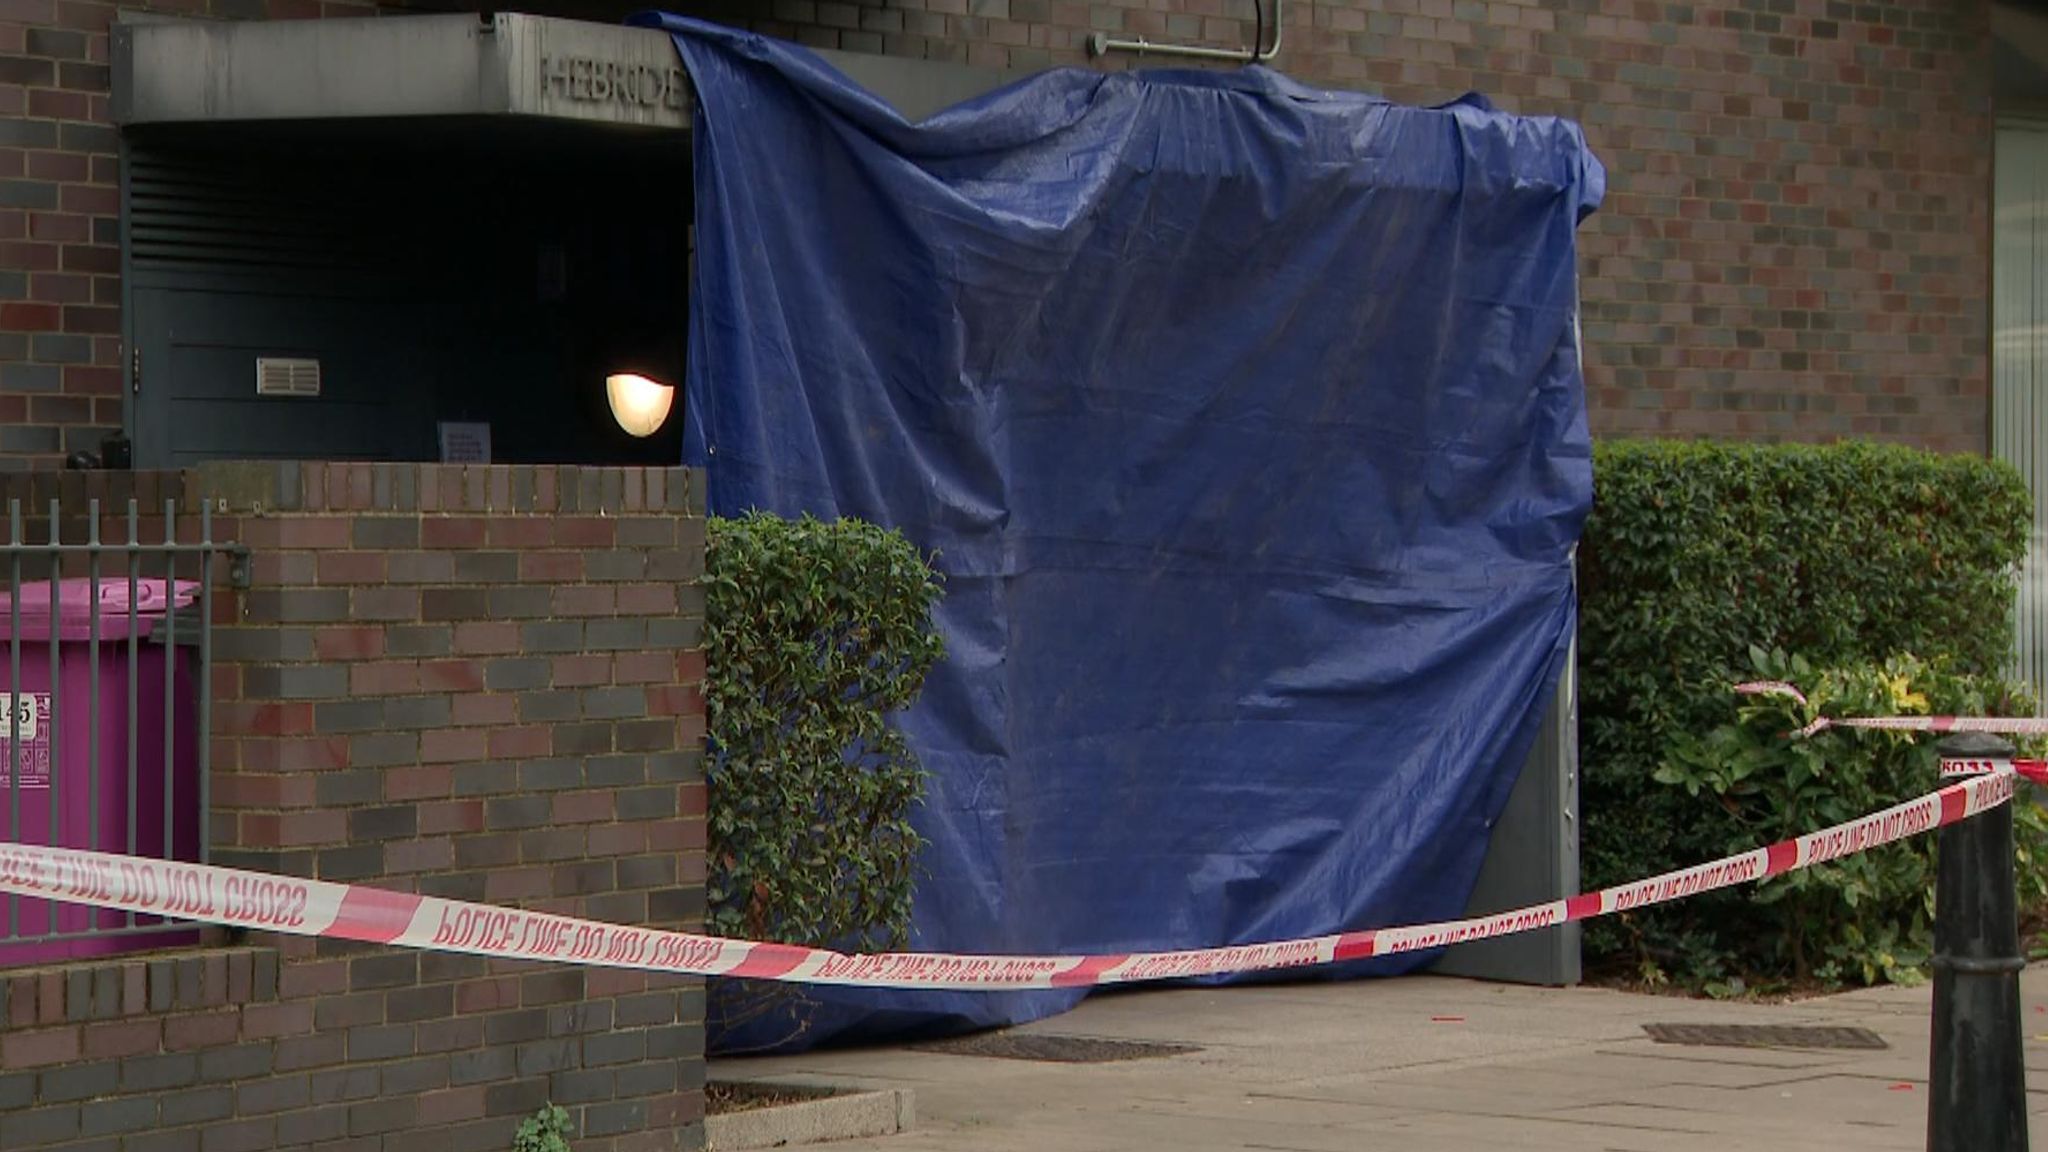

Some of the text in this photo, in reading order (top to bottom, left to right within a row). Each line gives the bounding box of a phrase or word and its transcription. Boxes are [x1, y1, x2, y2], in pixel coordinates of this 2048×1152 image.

[1808, 801, 1932, 863] POLICE LINE DO NOT CROSS
[1616, 885, 1656, 910] POLICE
